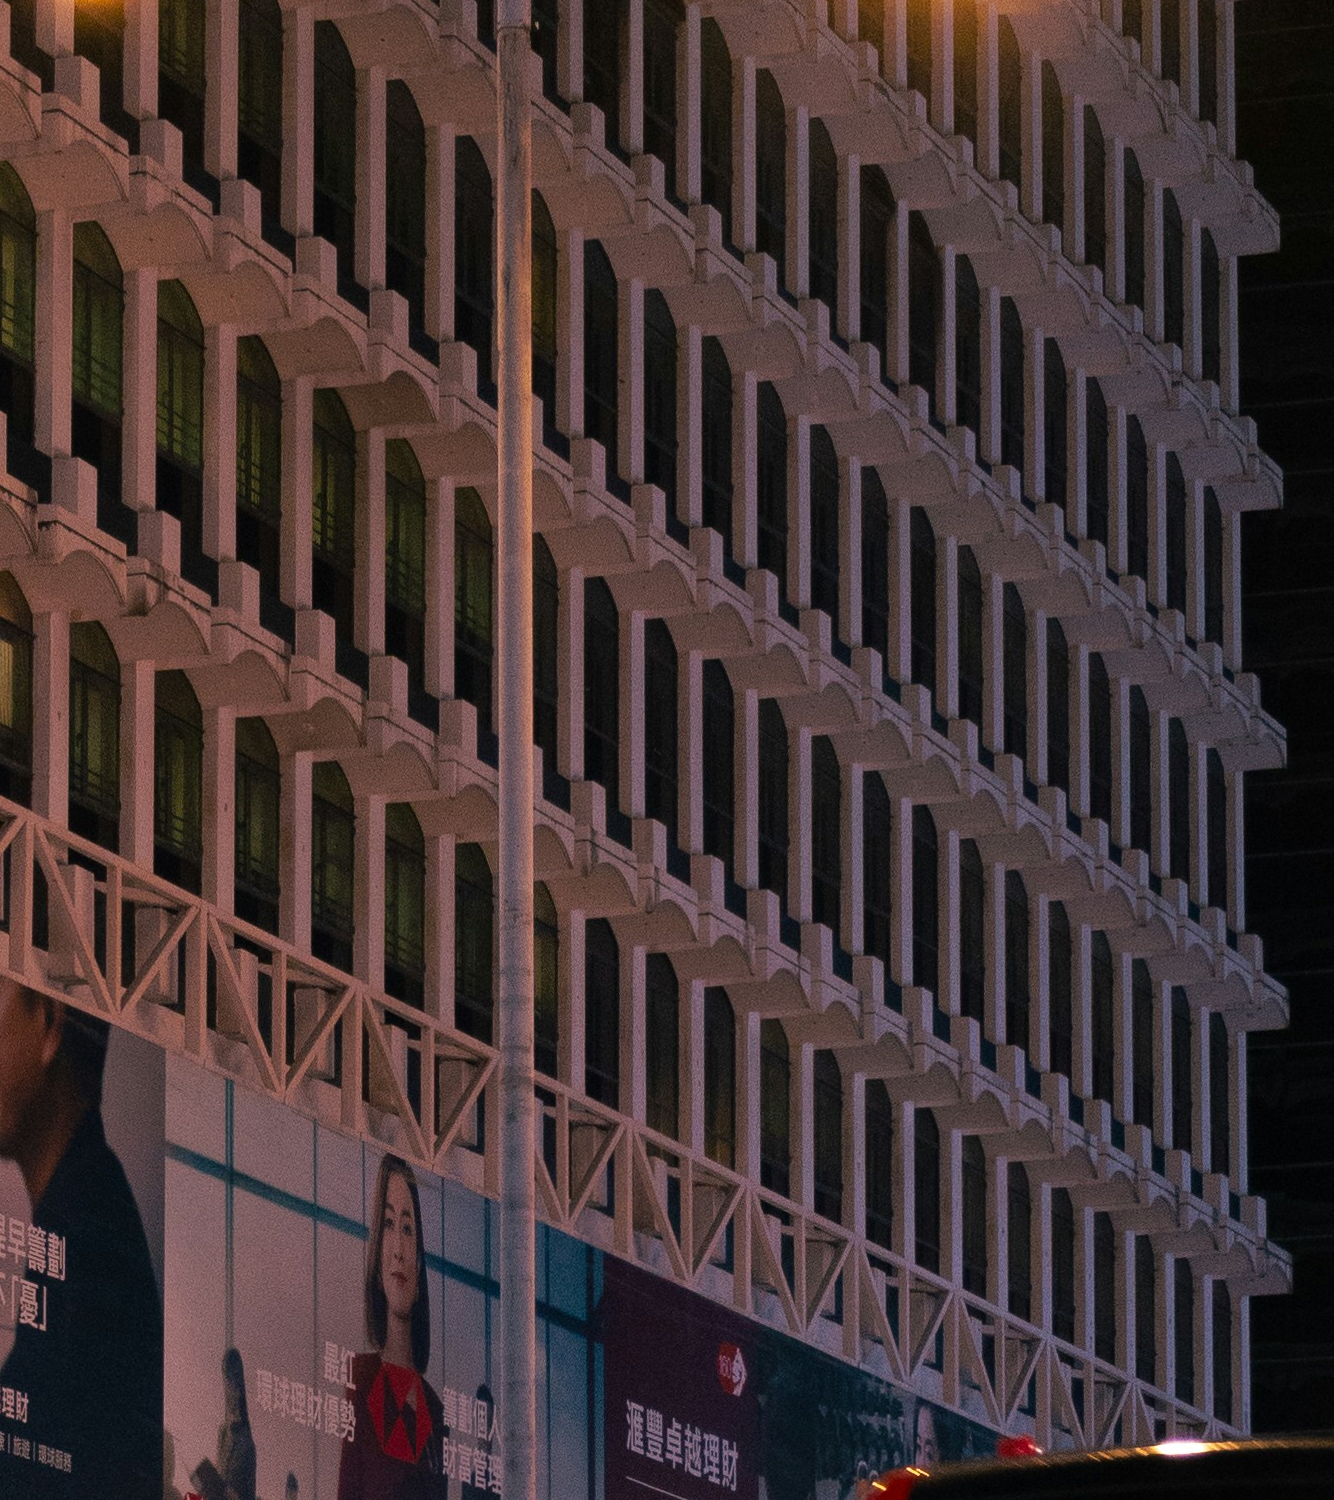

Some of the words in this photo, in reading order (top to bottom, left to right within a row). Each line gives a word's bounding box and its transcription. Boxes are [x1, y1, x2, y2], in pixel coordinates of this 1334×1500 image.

[323, 1340, 357, 1391] 最紅
[624, 1397, 740, 1493] 滙豐卓越理財
